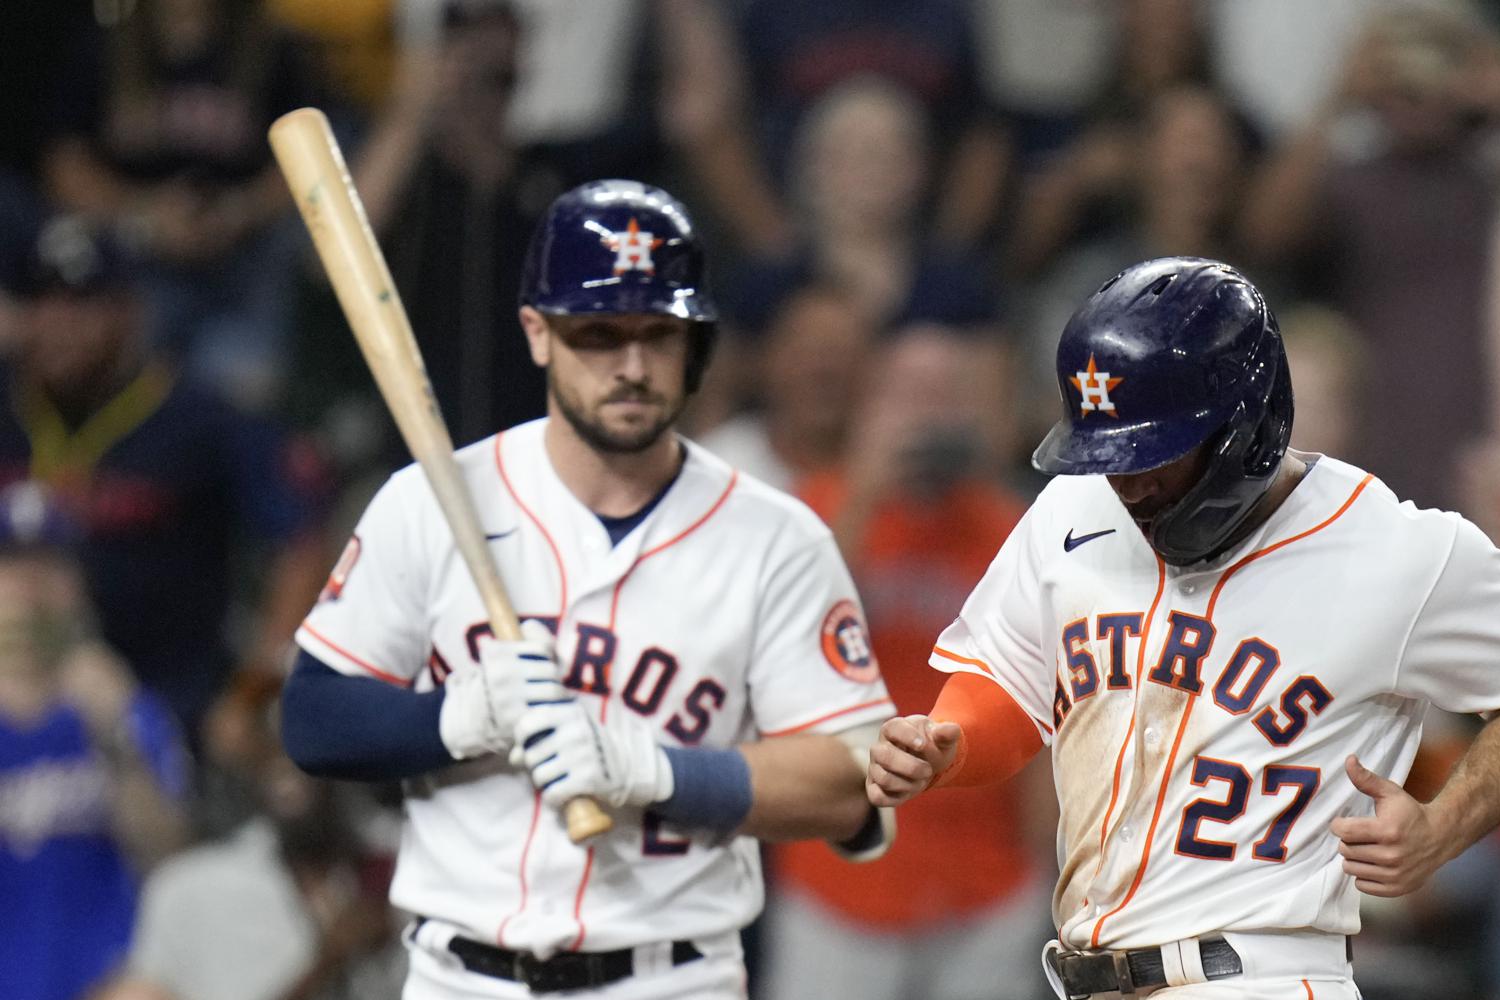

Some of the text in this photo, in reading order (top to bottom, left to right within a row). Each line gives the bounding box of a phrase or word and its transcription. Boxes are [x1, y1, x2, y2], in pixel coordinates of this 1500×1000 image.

[614, 231, 655, 271] H
[1075, 371, 1116, 412] H
[1173, 754, 1322, 864] 27
